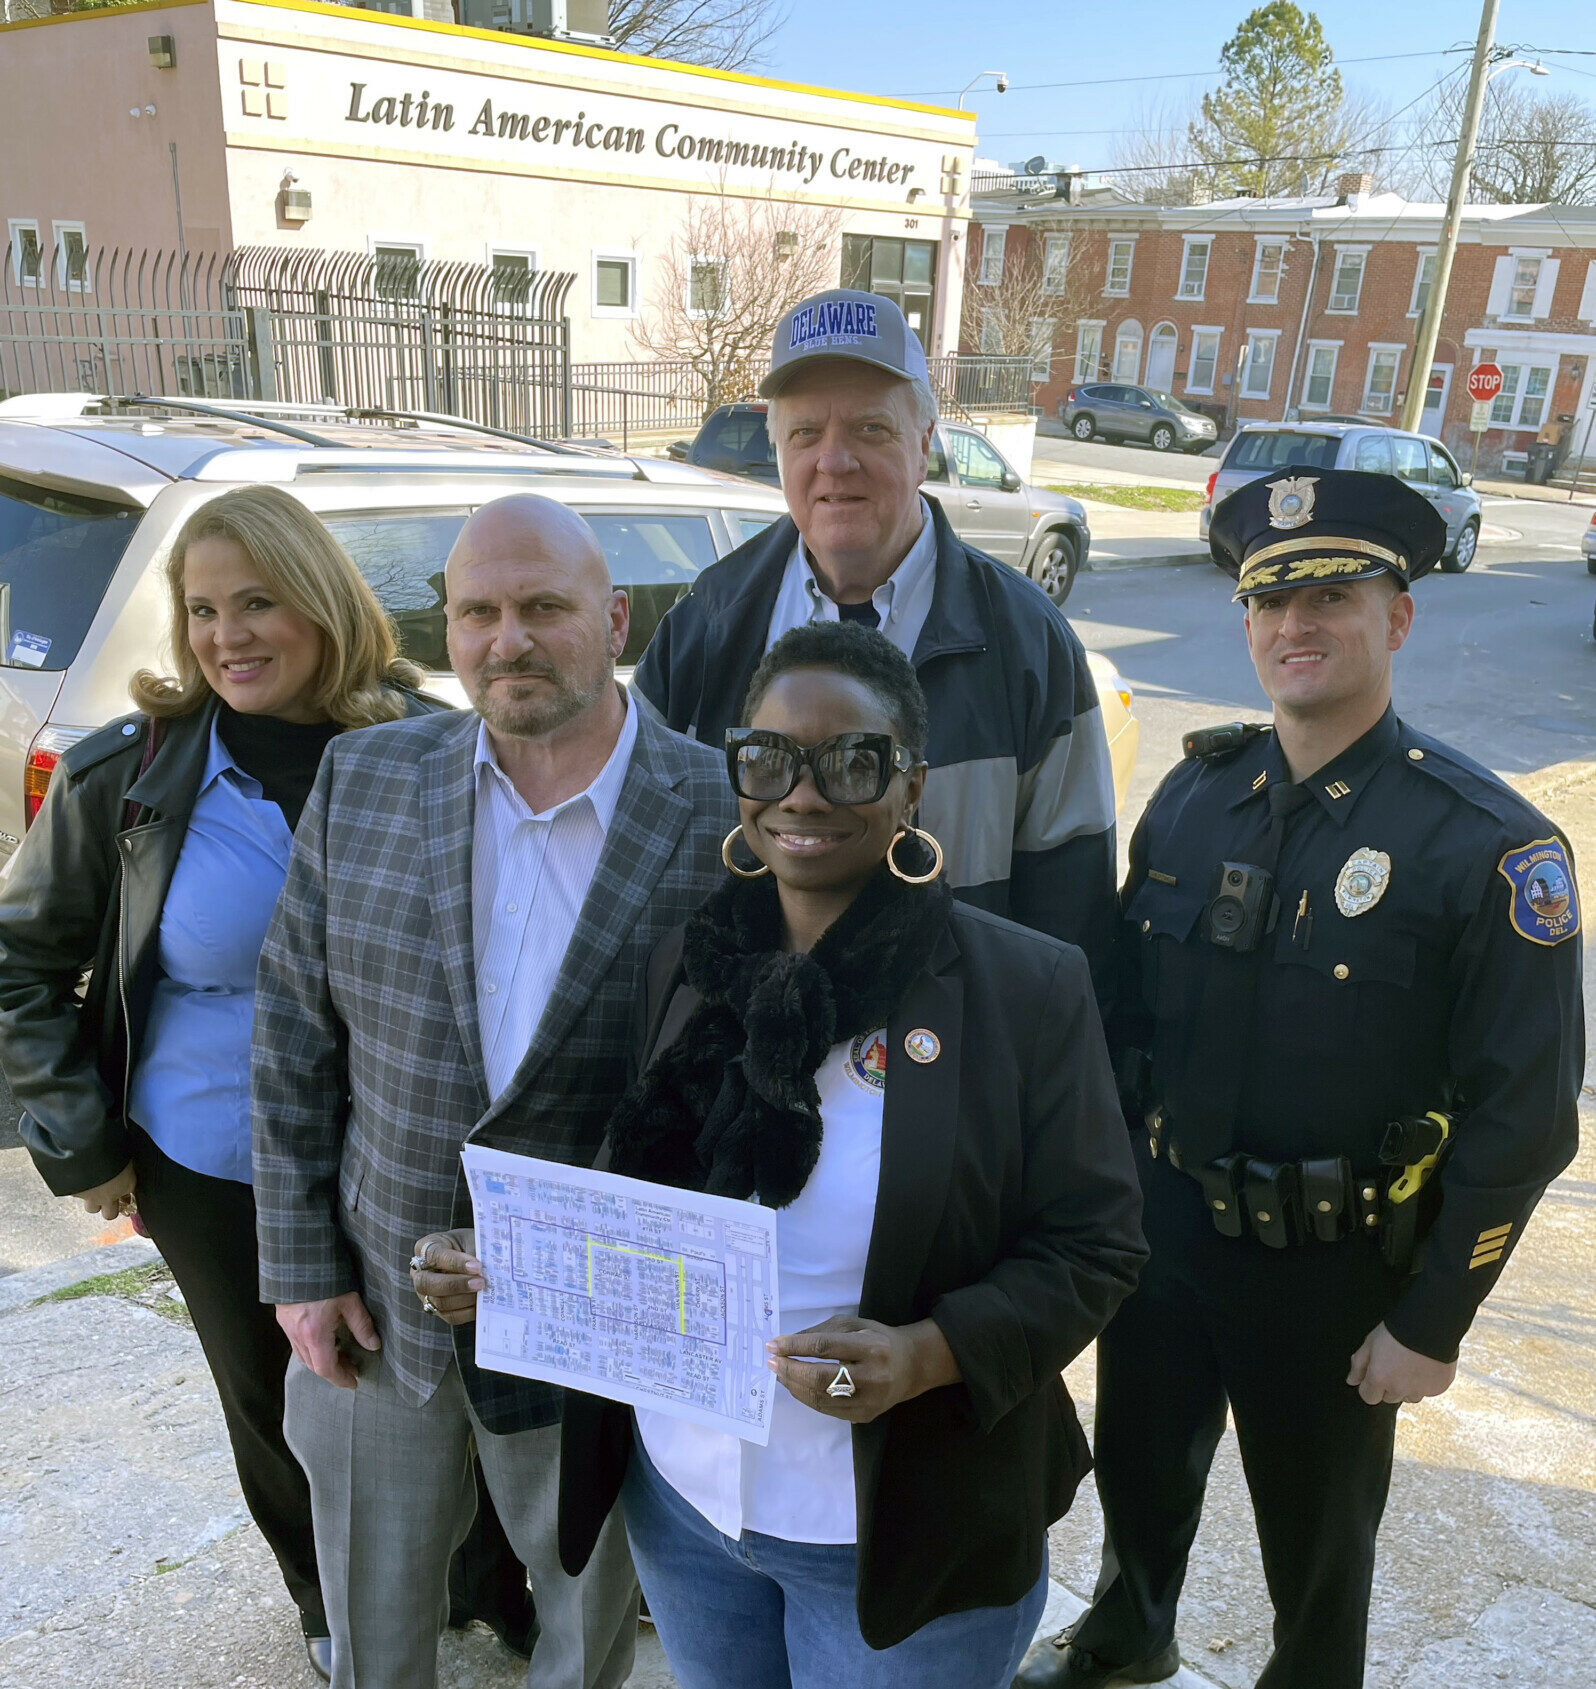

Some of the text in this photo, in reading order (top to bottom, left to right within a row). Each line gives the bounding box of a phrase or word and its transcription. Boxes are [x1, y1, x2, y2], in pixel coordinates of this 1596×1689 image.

[345, 82, 916, 186] Latin American Community Center
[904, 218, 919, 229] 301
[789, 301, 878, 350] DELAWARE
[803, 336, 859, 351] BLUE HENS
[1470, 374, 1500, 390] STOP
[1515, 850, 1562, 874] WILMINGTON
[1536, 909, 1573, 928] POLICE
[1549, 926, 1568, 936] DEL.
[679, 1348, 714, 1361] LANCASTER
